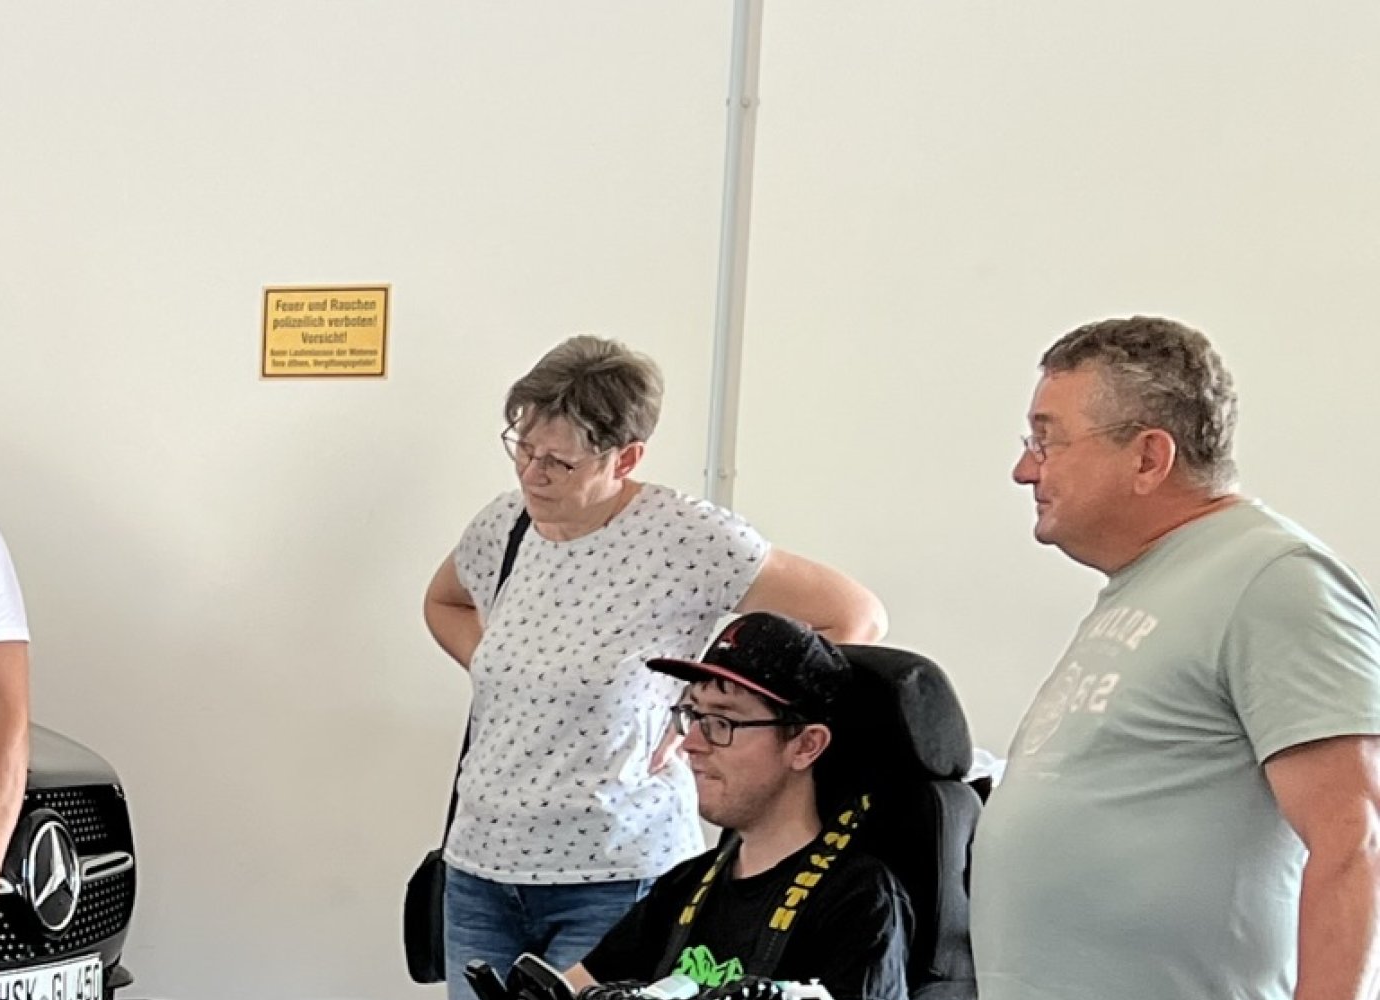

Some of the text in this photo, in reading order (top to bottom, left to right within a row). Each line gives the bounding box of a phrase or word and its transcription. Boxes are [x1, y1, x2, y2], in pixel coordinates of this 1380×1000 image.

[275, 298, 376, 311] Feuer und Rauchen
